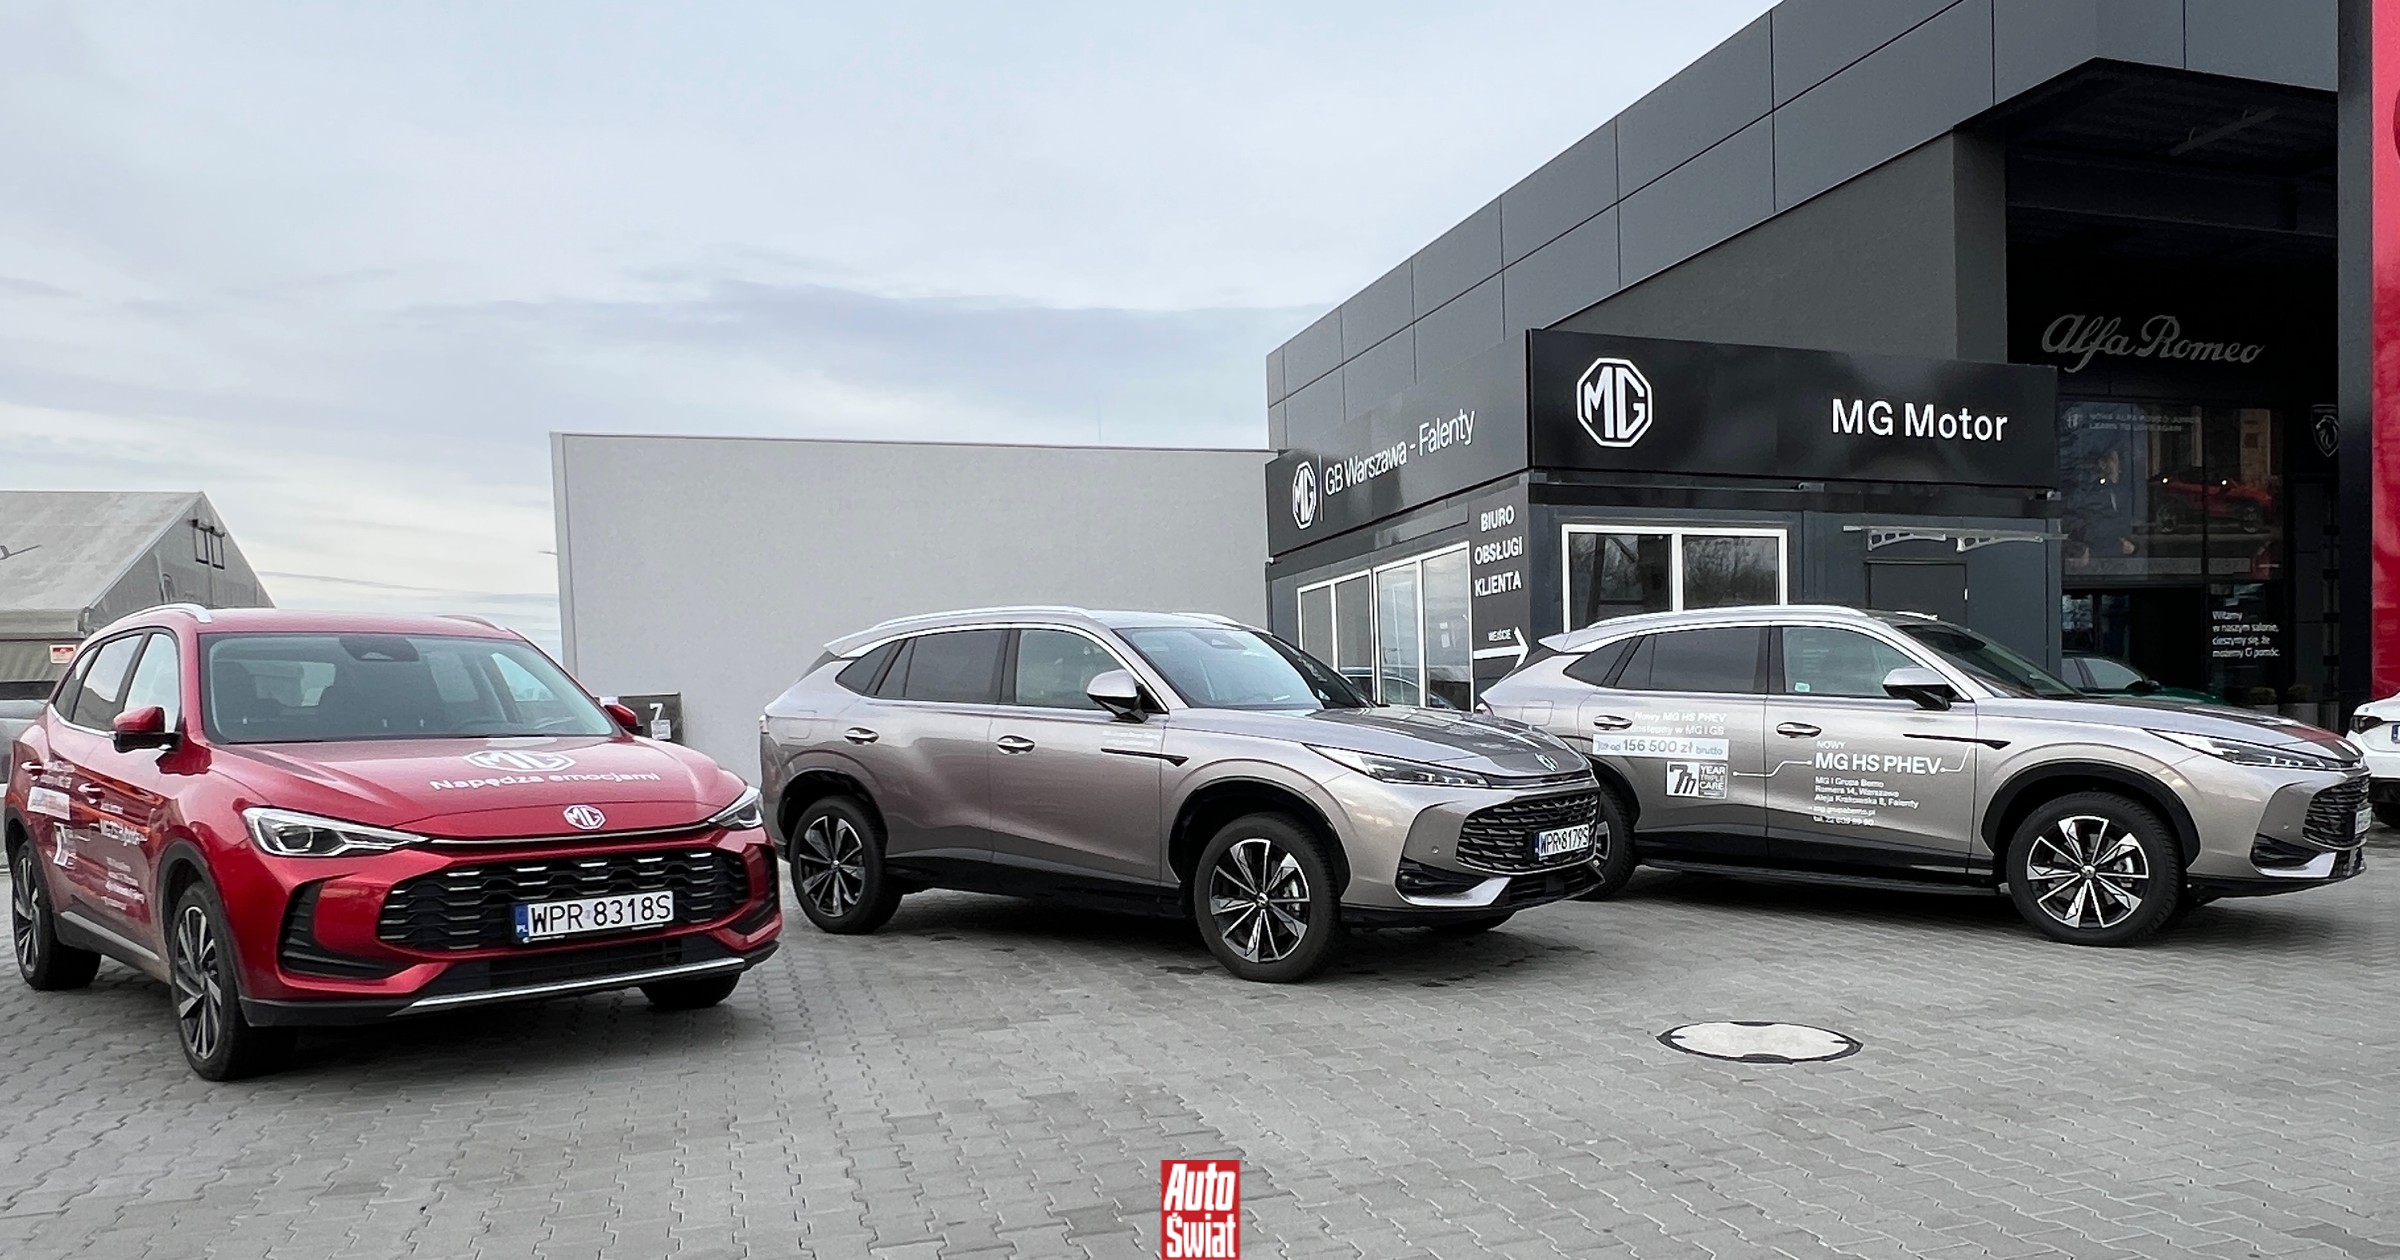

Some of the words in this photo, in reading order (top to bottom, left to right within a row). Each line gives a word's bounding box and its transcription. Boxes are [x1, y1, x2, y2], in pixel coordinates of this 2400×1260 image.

[2041, 313, 2135, 373] Alfa
[2135, 314, 2265, 364] Romeo
[1580, 362, 1649, 443] MG
[1831, 398, 1893, 436] MG
[1903, 402, 2008, 441] Motor
[1325, 463, 1343, 495] GB
[1344, 441, 1407, 488] Warszawa
[1418, 408, 1476, 456] Falenty
[1294, 465, 1315, 525] MG
[1480, 505, 1515, 532] BIURO
[1474, 536, 1523, 565] OBSŁUGI
[1474, 570, 1522, 597] KLIENTA
[649, 703, 663, 721] 7
[1634, 711, 1660, 723] Nowy
[1662, 712, 1680, 722] MG
[1682, 712, 1696, 722] HS
[1696, 712, 1728, 723] PHEV
[1623, 739, 1646, 752] 156
[1648, 740, 1677, 753] 500
[1680, 741, 1693, 754] zł
[1700, 765, 1726, 775] YEAR
[1815, 752, 1849, 771] MG
[1852, 753, 1880, 772] HS
[1883, 755, 1942, 774] PHEV
[429, 774, 545, 791] Napędza
[549, 772, 662, 783] emocjami
[1699, 781, 1725, 790] CARE
[1815, 776, 1829, 785] MG
[565, 806, 603, 828] MG
[1540, 832, 1559, 854] WPR
[531, 903, 583, 934] WPR
[593, 894, 671, 927] 8318S
